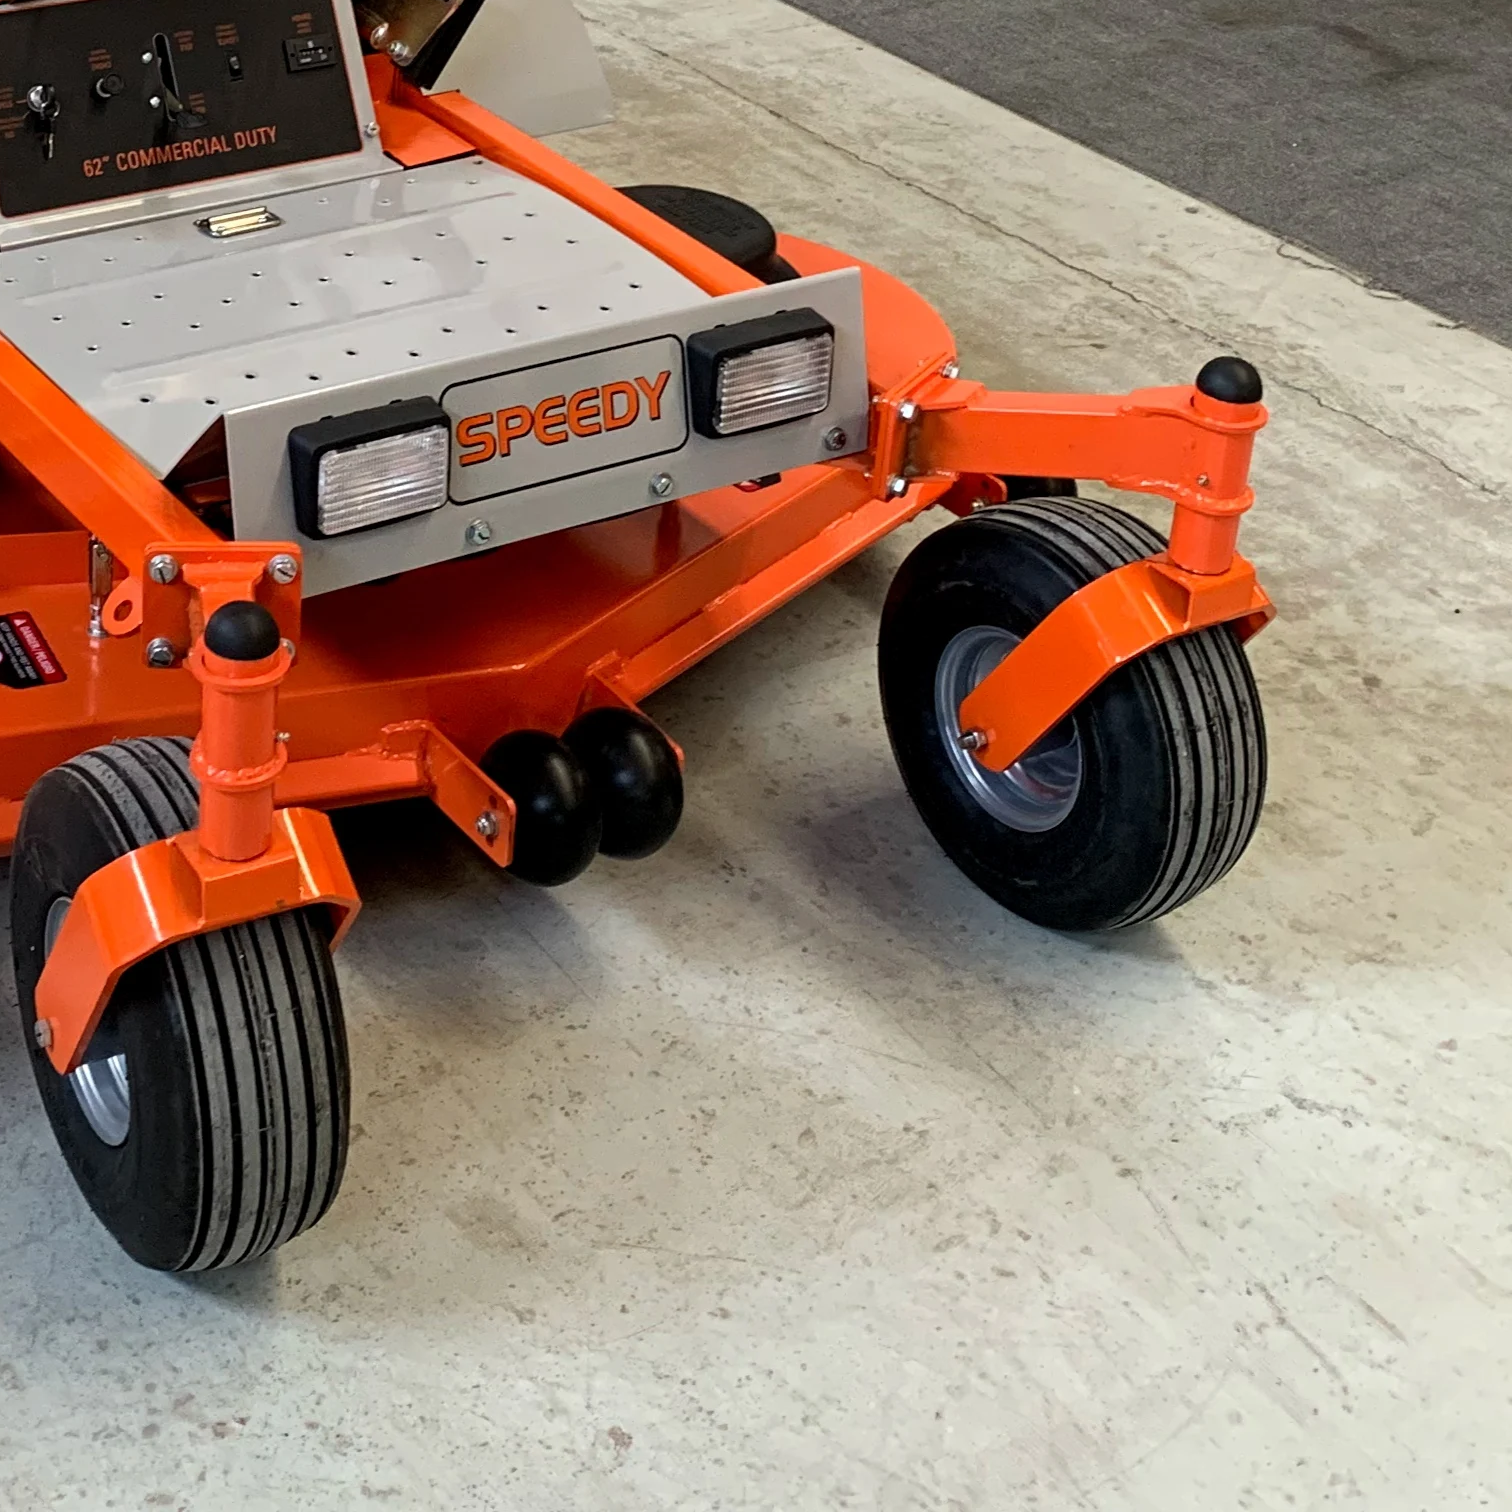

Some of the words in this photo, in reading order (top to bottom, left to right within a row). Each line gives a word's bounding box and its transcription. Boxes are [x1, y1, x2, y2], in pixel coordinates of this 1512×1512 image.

[116, 134, 232, 172] COMMERCIAL
[234, 125, 277, 150] DUTY
[456, 370, 671, 468] SPEEDY
